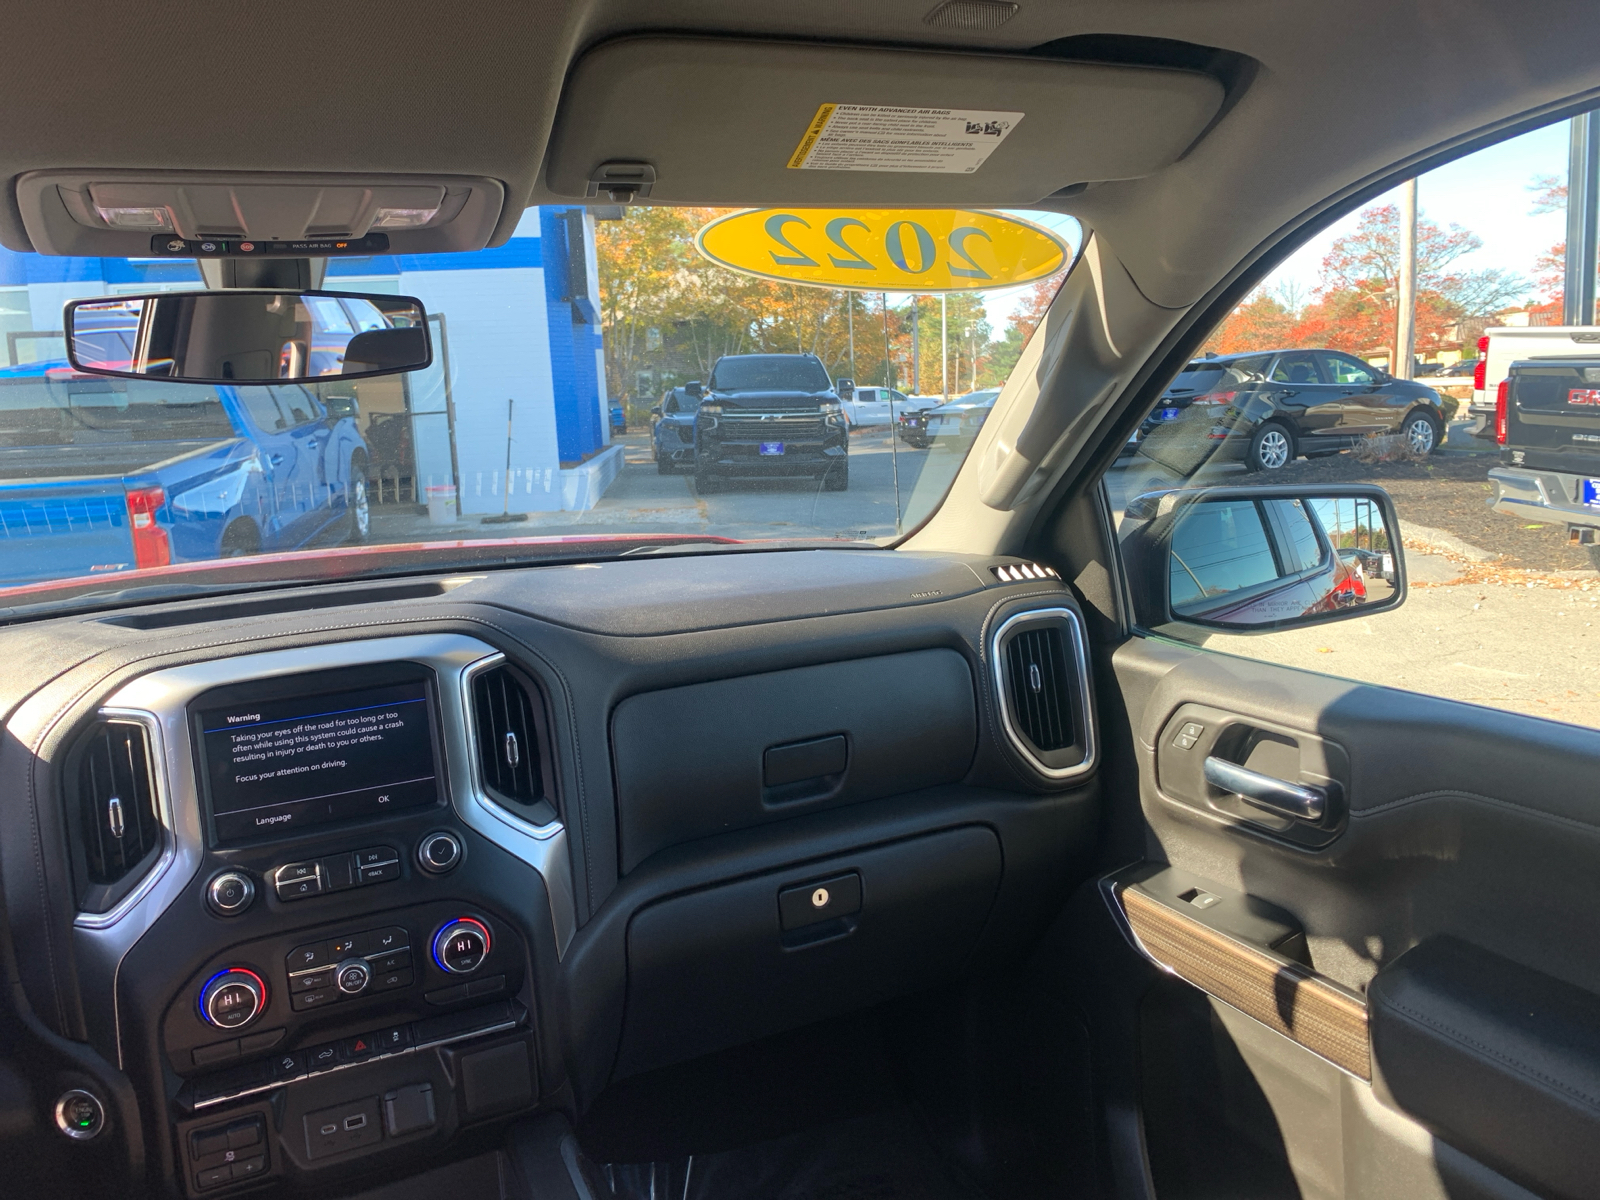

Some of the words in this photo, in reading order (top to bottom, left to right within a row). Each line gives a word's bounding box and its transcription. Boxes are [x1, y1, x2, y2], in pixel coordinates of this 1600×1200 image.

[241, 243, 254, 251] SOS
[227, 713, 260, 723] Warning
[231, 734, 256, 743] Taking
[257, 731, 273, 741] your
[275, 728, 291, 738] eyes
[293, 725, 303, 733] off
[305, 724, 316, 732] the
[318, 721, 334, 730] road
[347, 718, 359, 726] too
[361, 715, 376, 724] long
[386, 711, 398, 720] too
[232, 743, 252, 753] often
[254, 740, 272, 749] while
[274, 737, 293, 746] using
[295, 734, 309, 742] this
[310, 731, 335, 741] system
[337, 727, 356, 737] could
[357, 725, 377, 734] cause
[385, 721, 404, 730] crash
[233, 751, 265, 763] resulting
[276, 746, 295, 756] injury
[306, 742, 326, 751] death
[336, 739, 349, 748] you
[360, 734, 383, 743] others.
[236, 773, 257, 783] Focus
[259, 771, 275, 780] your
[277, 766, 309, 776] attention
[322, 759, 347, 768] driving.
[378, 795, 389, 803] OK
[256, 813, 292, 825] Language
[457, 939, 470, 952] HI
[224, 993, 240, 1006] HI
[228, 1012, 240, 1020] AUTO
